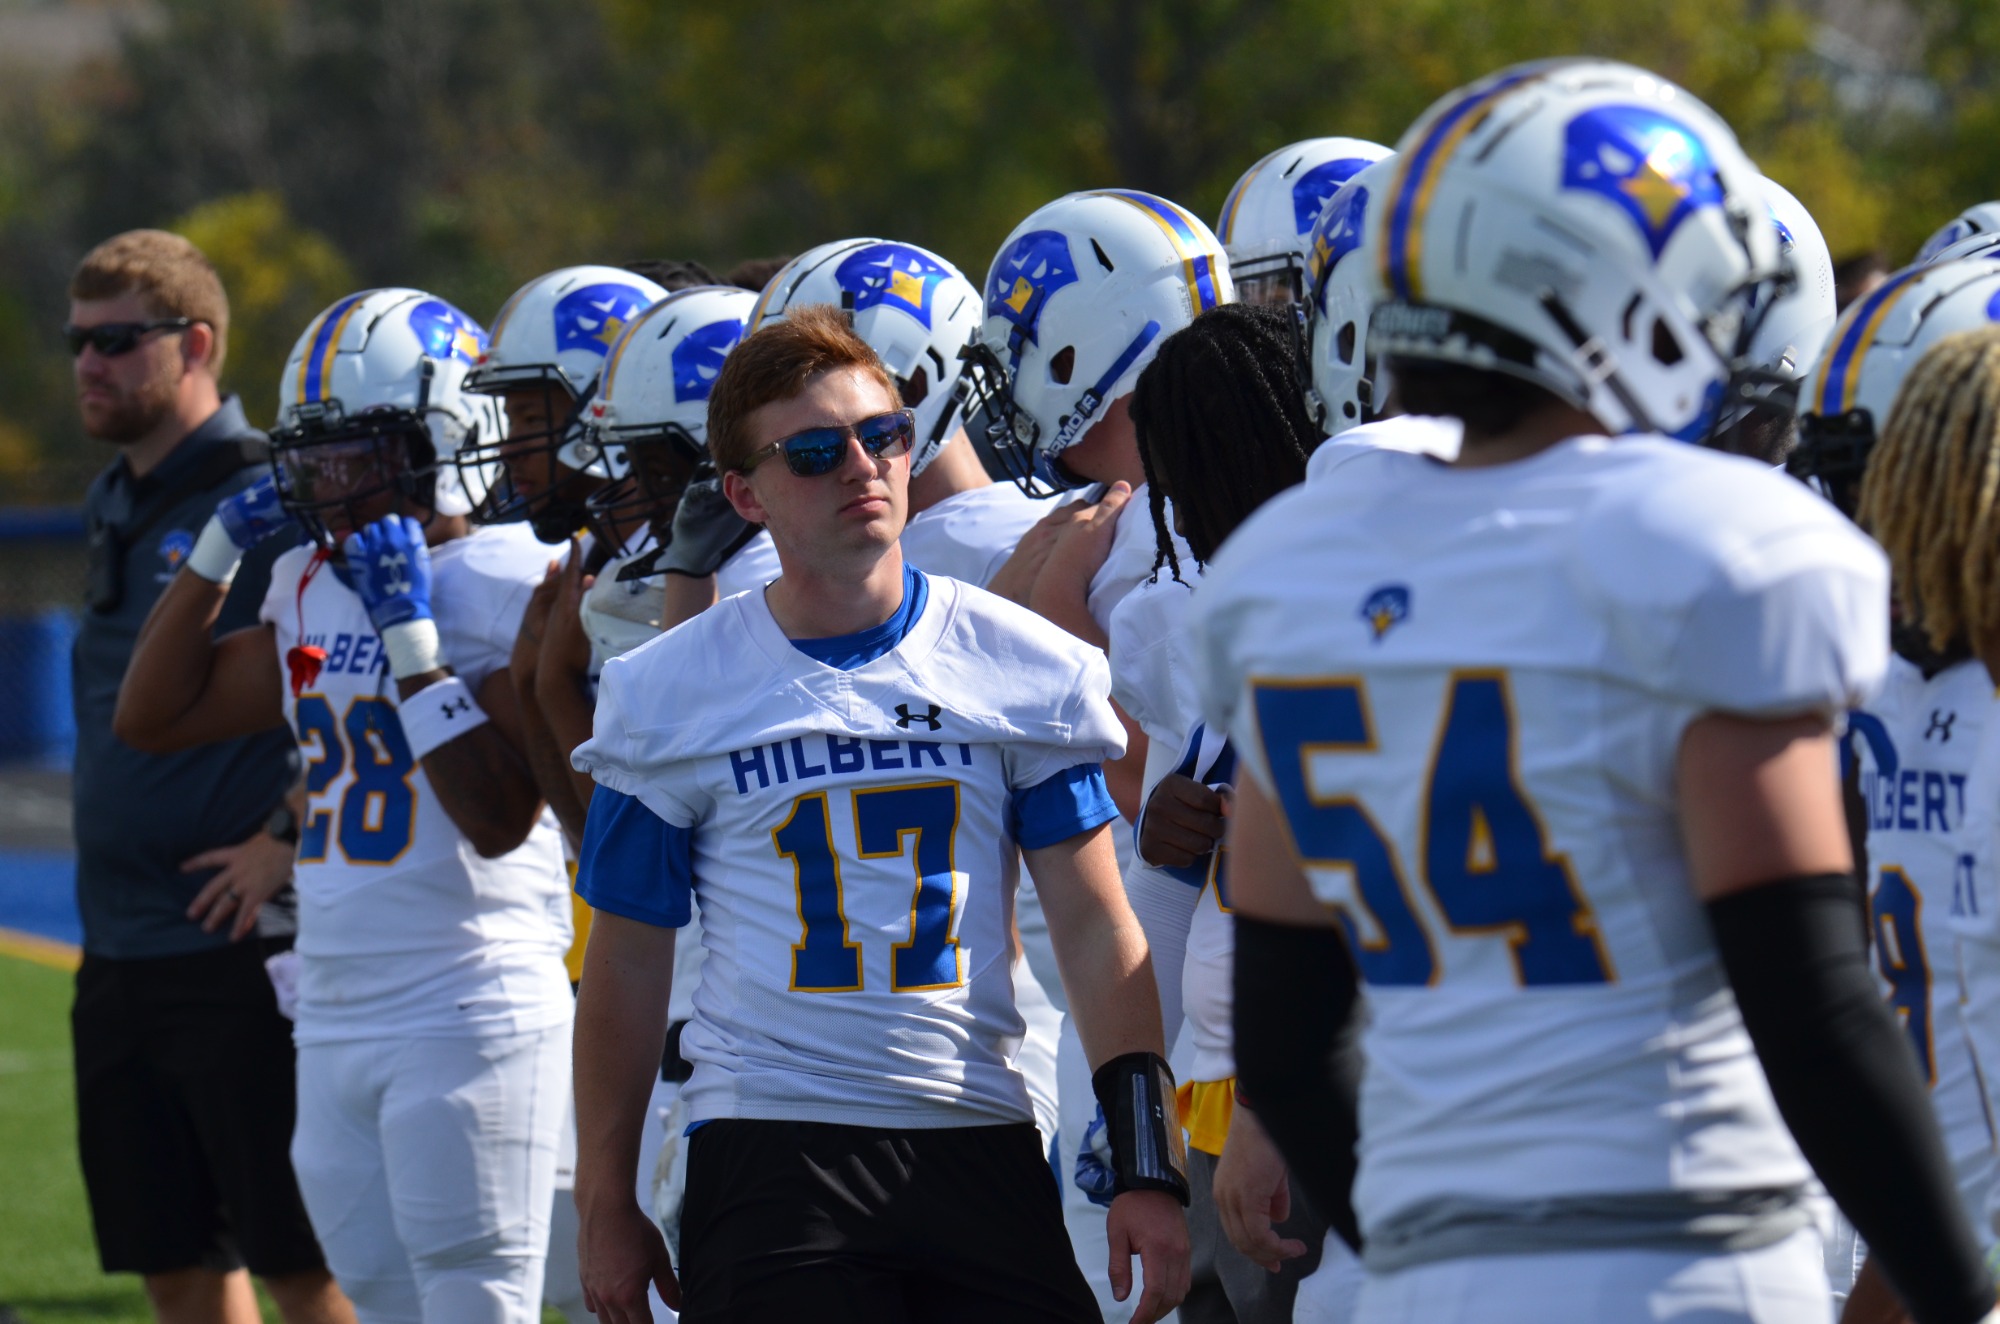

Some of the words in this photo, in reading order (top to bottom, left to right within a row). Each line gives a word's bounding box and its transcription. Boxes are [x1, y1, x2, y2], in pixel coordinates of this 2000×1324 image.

[295, 692, 420, 866] 28
[1249, 666, 1618, 988] 54
[770, 780, 963, 993] 17
